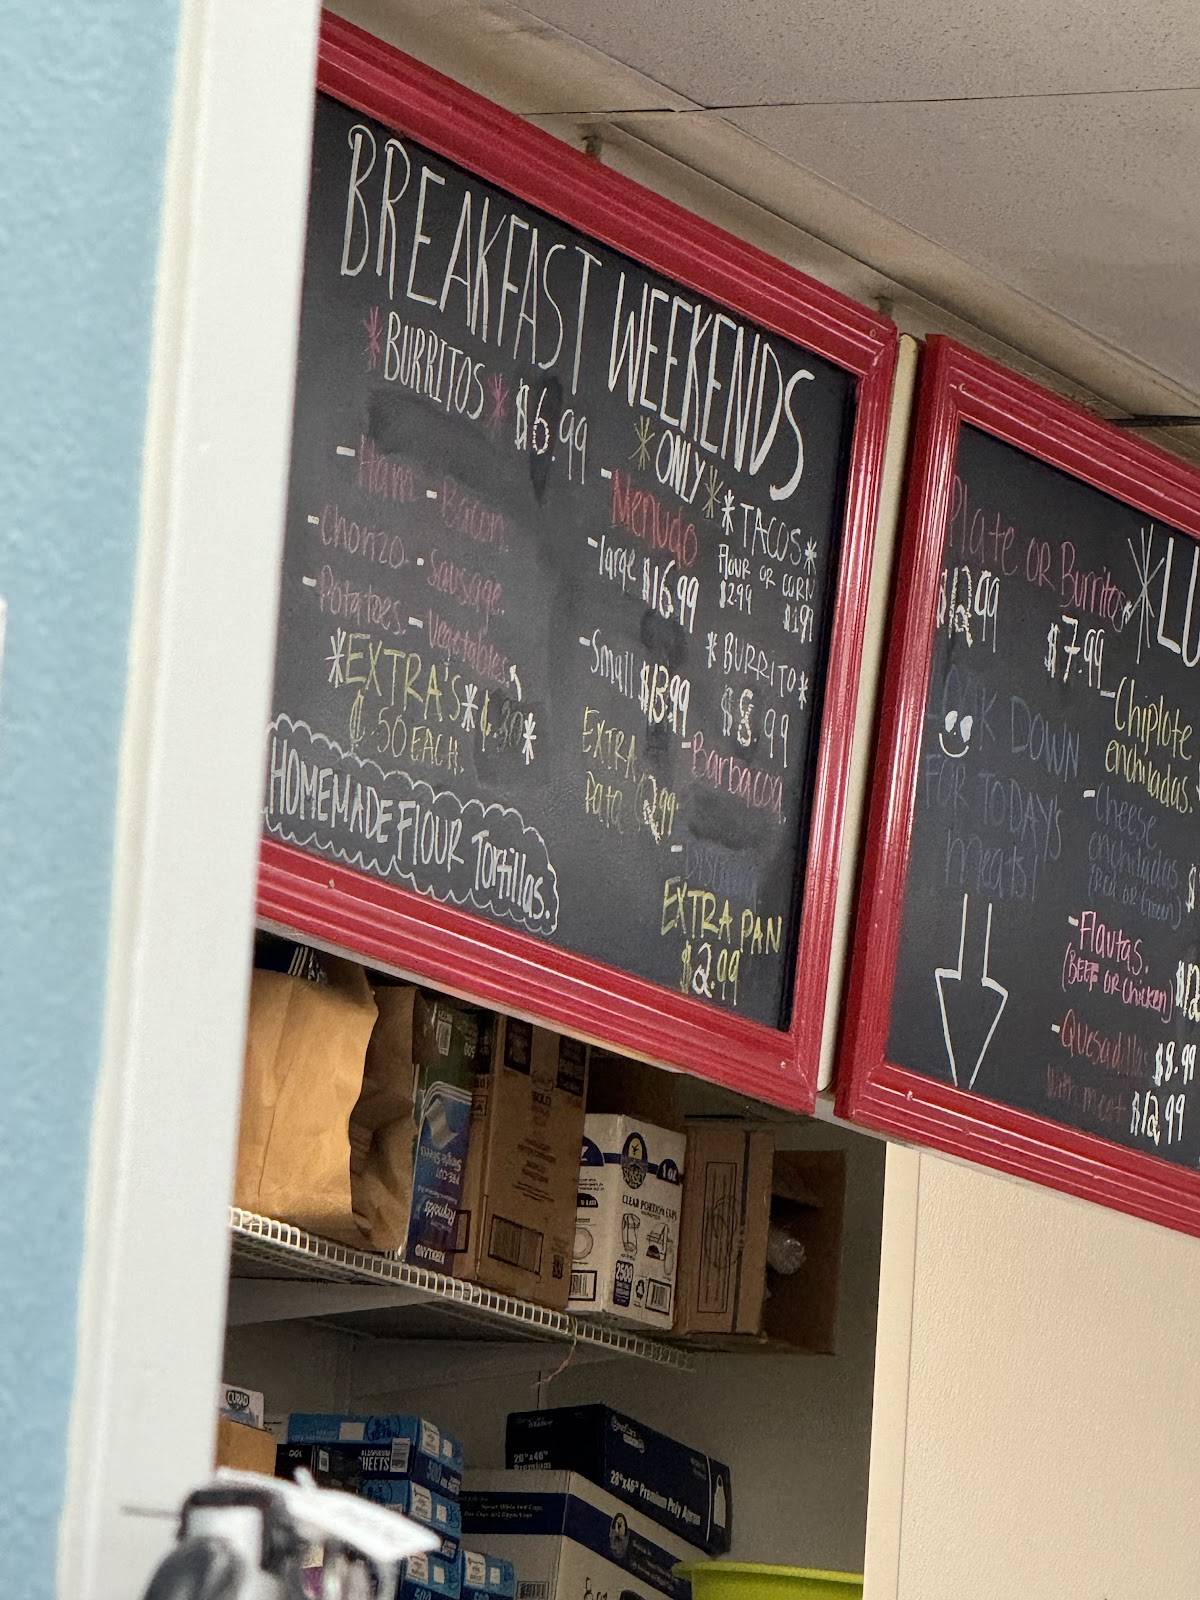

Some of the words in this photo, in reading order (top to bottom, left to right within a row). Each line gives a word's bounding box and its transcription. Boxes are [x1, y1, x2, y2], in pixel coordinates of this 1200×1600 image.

[341, 124, 602, 396] BREAKFAST
[608, 272, 815, 501] WEEKENDS
[384, 311, 486, 420] BURRITOS
[515, 378, 588, 485] $6.99
[656, 430, 706, 504] ONLY
[610, 469, 697, 569] Menudo
[740, 503, 802, 565] TACOS
[724, 631, 797, 697] BURRITO
[1044, 615, 1105, 690] $7.99
[270, 736, 393, 843] HOMEMADE
[660, 876, 733, 944] EXTRA
[740, 908, 782, 955] PAN
